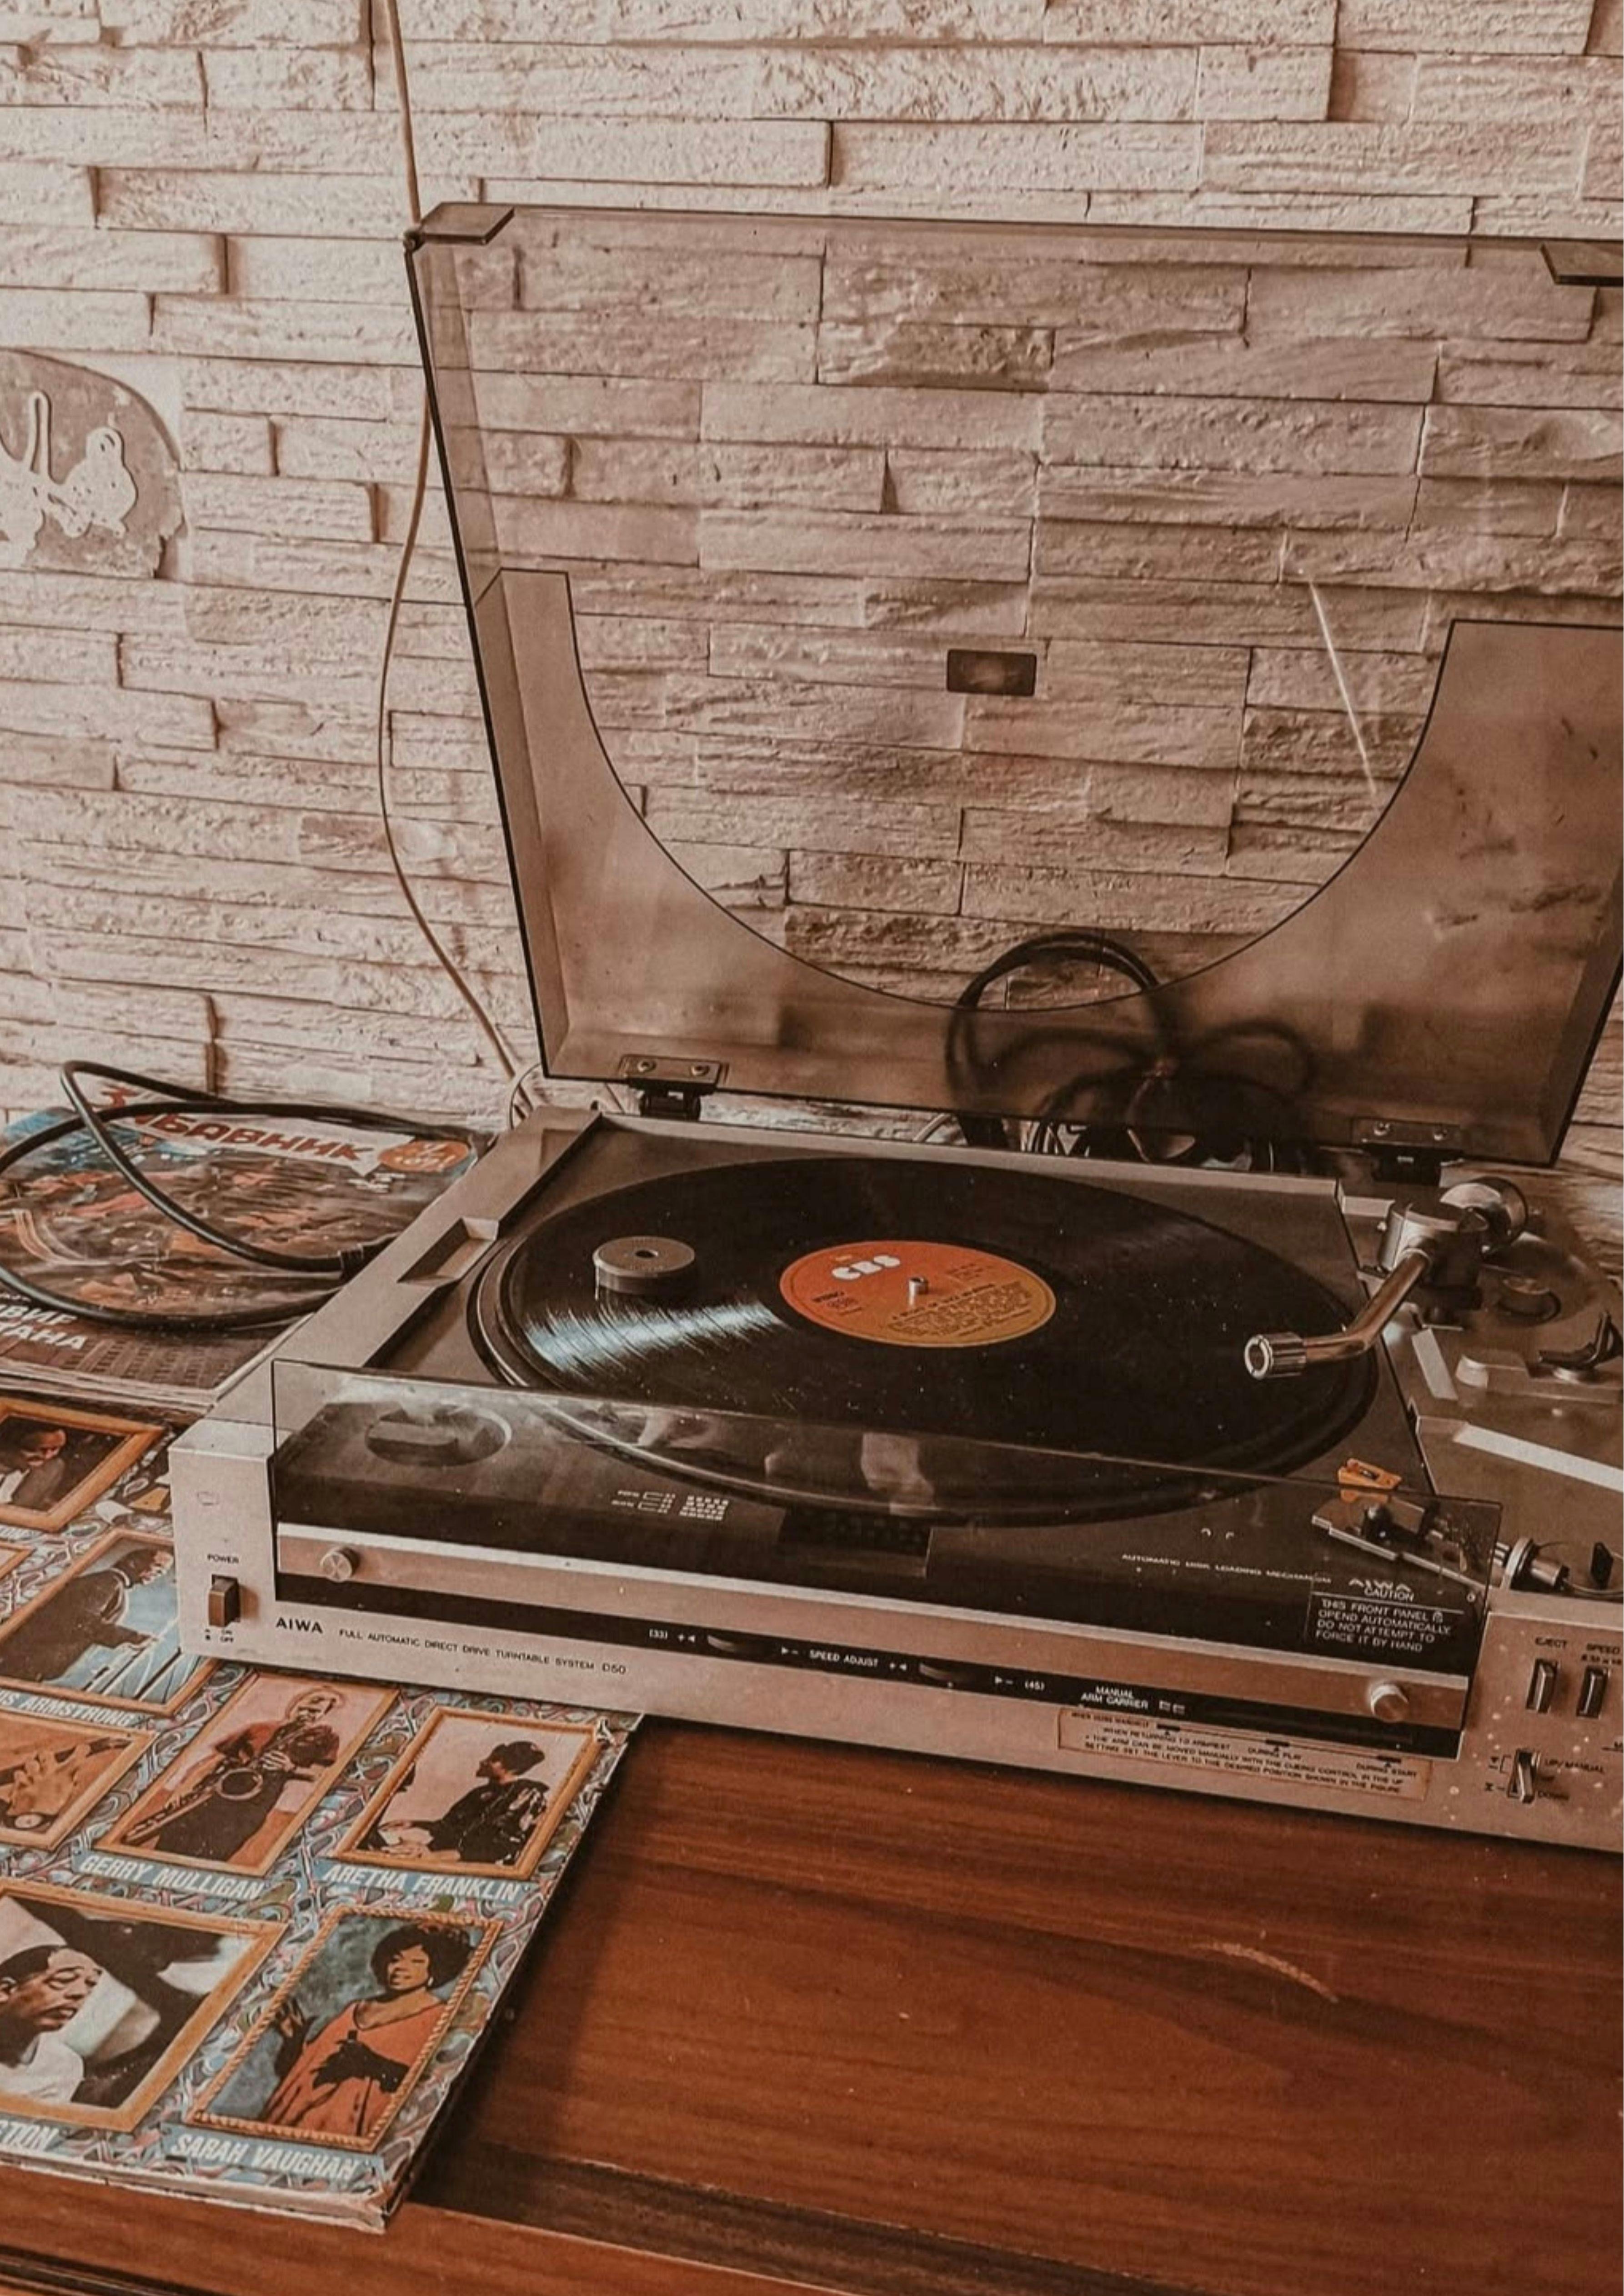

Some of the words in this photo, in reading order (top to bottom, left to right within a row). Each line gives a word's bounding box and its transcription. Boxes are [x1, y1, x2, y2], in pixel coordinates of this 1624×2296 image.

[207, 1554, 240, 1564] POWER
[1364, 1587, 1415, 1602] CAUTION
[1351, 1602, 1389, 1615] FRONT
[1393, 1608, 1429, 1621] PANEL
[1318, 1619, 1334, 1630] DO
[1338, 1622, 1361, 1633] NOT
[1363, 1626, 1415, 1641] ATTEMPT
[1420, 1634, 1435, 1644] TO
[1361, 1616, 1451, 1636] AUTOMATICALLY
[276, 1617, 323, 1634] AIWA
[339, 1629, 363, 1640] FULL
[368, 1633, 420, 1647] AUTOMATIC
[425, 1639, 457, 1652] DIRECT
[463, 1644, 490, 1656] DRIVE
[496, 1649, 549, 1664] TURNTABLE
[555, 1657, 594, 1670] SYSTEM
[601, 1663, 626, 1675] D50
[1316, 1630, 1355, 1643] FORCE
[1358, 1636, 1368, 1645] IT
[1372, 1637, 1387, 1648] BY
[1391, 1640, 1423, 1652] HAND
[809, 1649, 840, 1663] SPEED
[843, 1654, 879, 1668] ADJUST
[1024, 1679, 1045, 1691] (45)
[1081, 1693, 1103, 1704] ARM
[1106, 1696, 1149, 1710] CARRIER
[1096, 1685, 1133, 1699] MANUAL
[19, 1696, 136, 1727] ARMSTRONG
[80, 1856, 153, 1881] GERRY
[152, 1868, 265, 1901] MULLIGAN
[322, 1863, 407, 1891] ARETHA
[412, 1875, 521, 1901] FRANKLIN
[170, 2133, 249, 2163] SARAH
[251, 2145, 359, 2181] VAUGHAN
